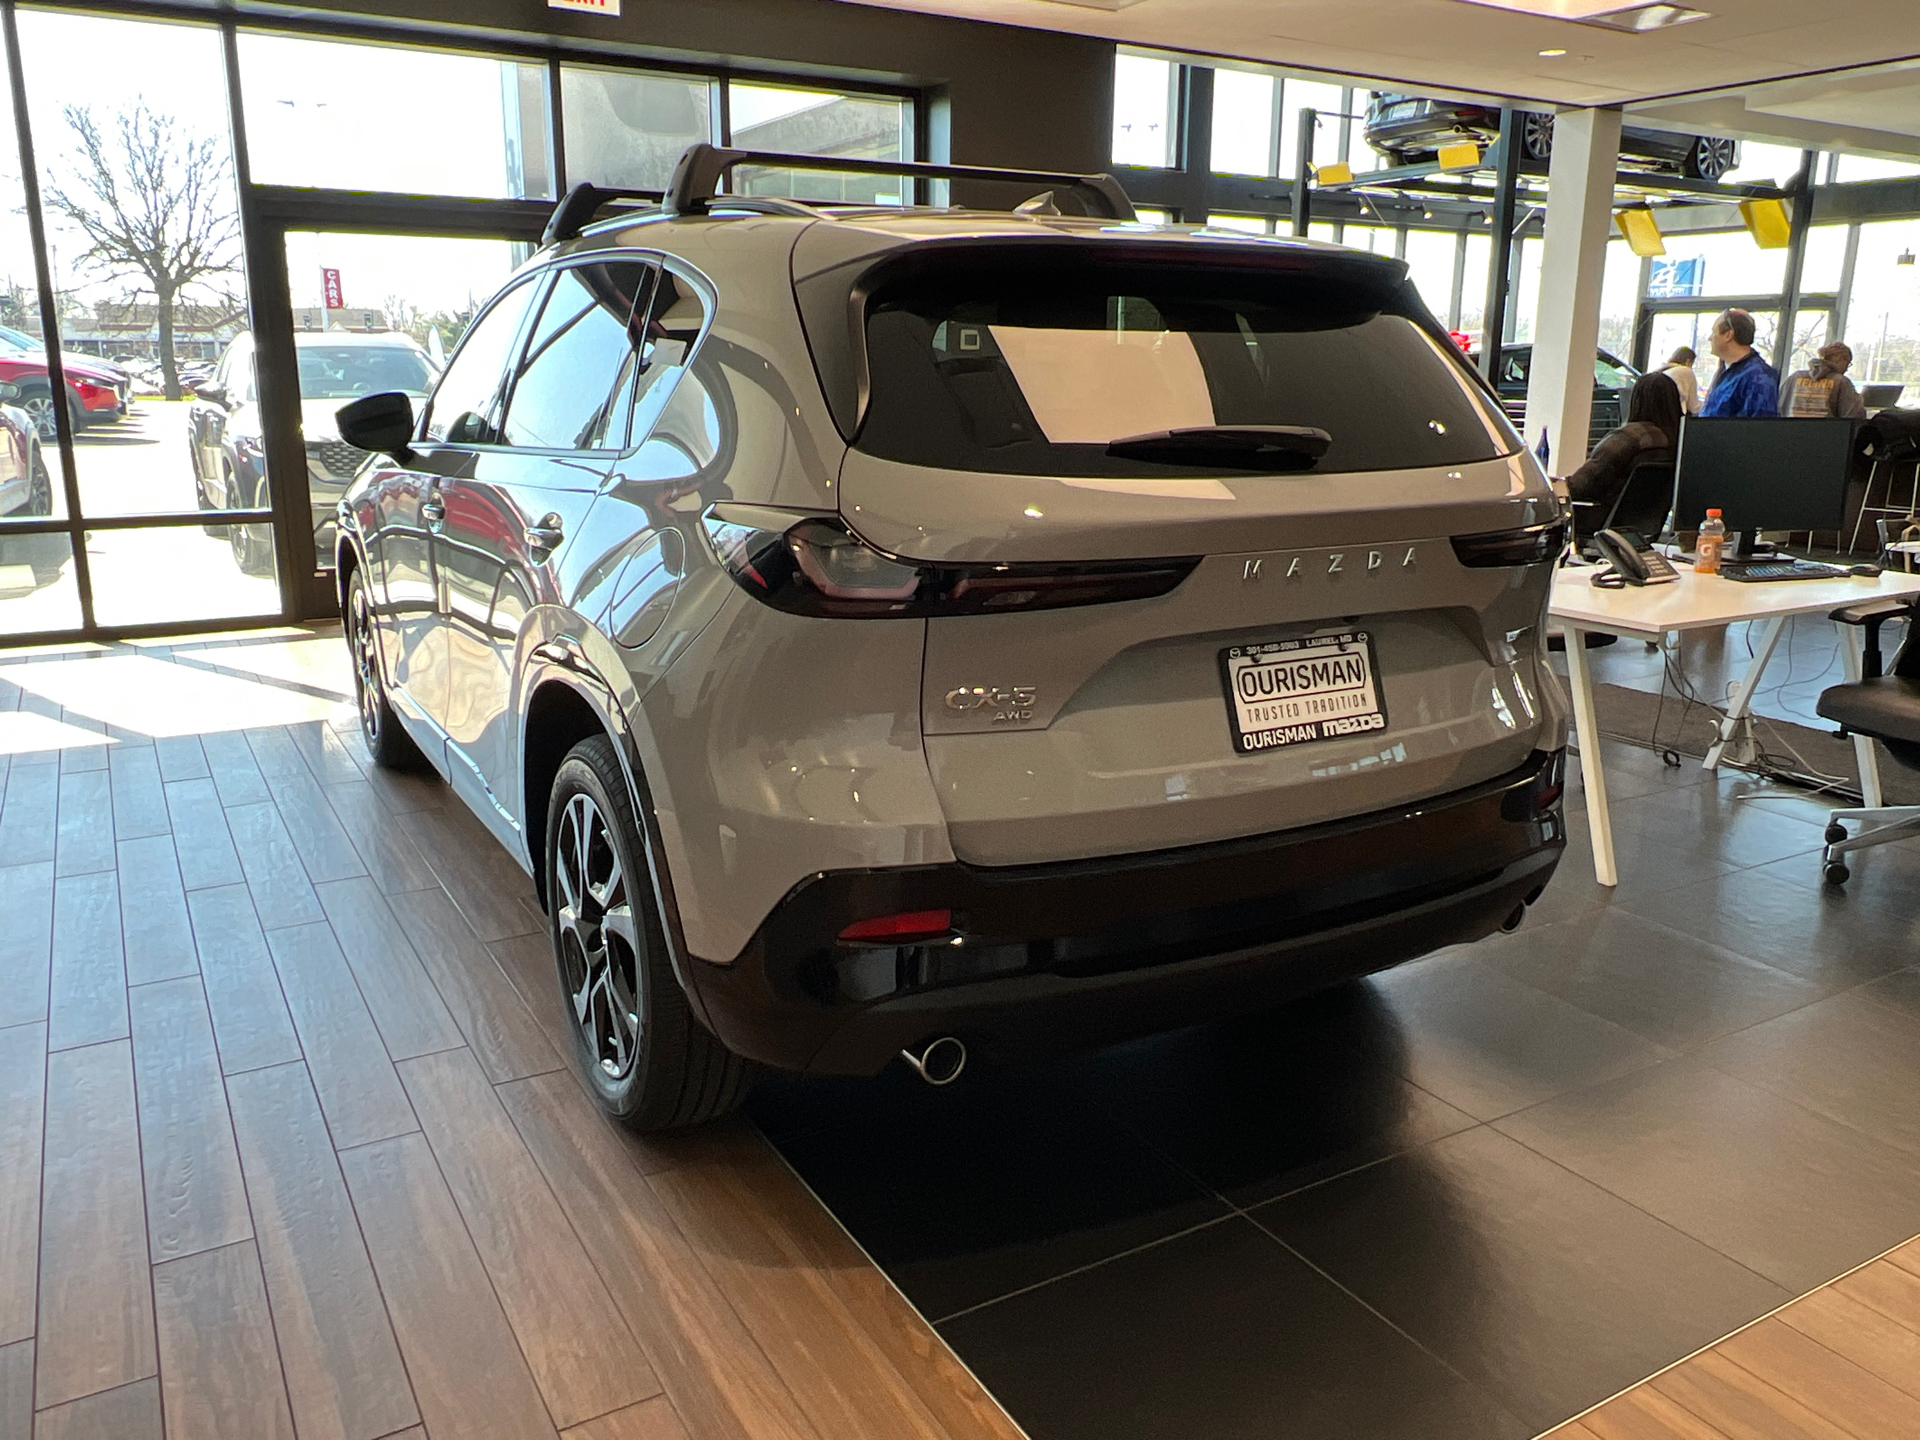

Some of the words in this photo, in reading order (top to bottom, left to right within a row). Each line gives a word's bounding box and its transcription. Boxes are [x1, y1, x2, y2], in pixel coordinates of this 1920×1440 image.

[327, 270, 339, 308] CARS
[1243, 547, 1416, 579] MAZDA
[1241, 658, 1362, 698] OURISMAN
[945, 687, 1036, 709] CX-5
[1246, 703, 1300, 723] TRUSTED
[1305, 693, 1368, 715] TRADITION
[993, 710, 1033, 721] AWD
[1243, 724, 1317, 750] OURISMAN
